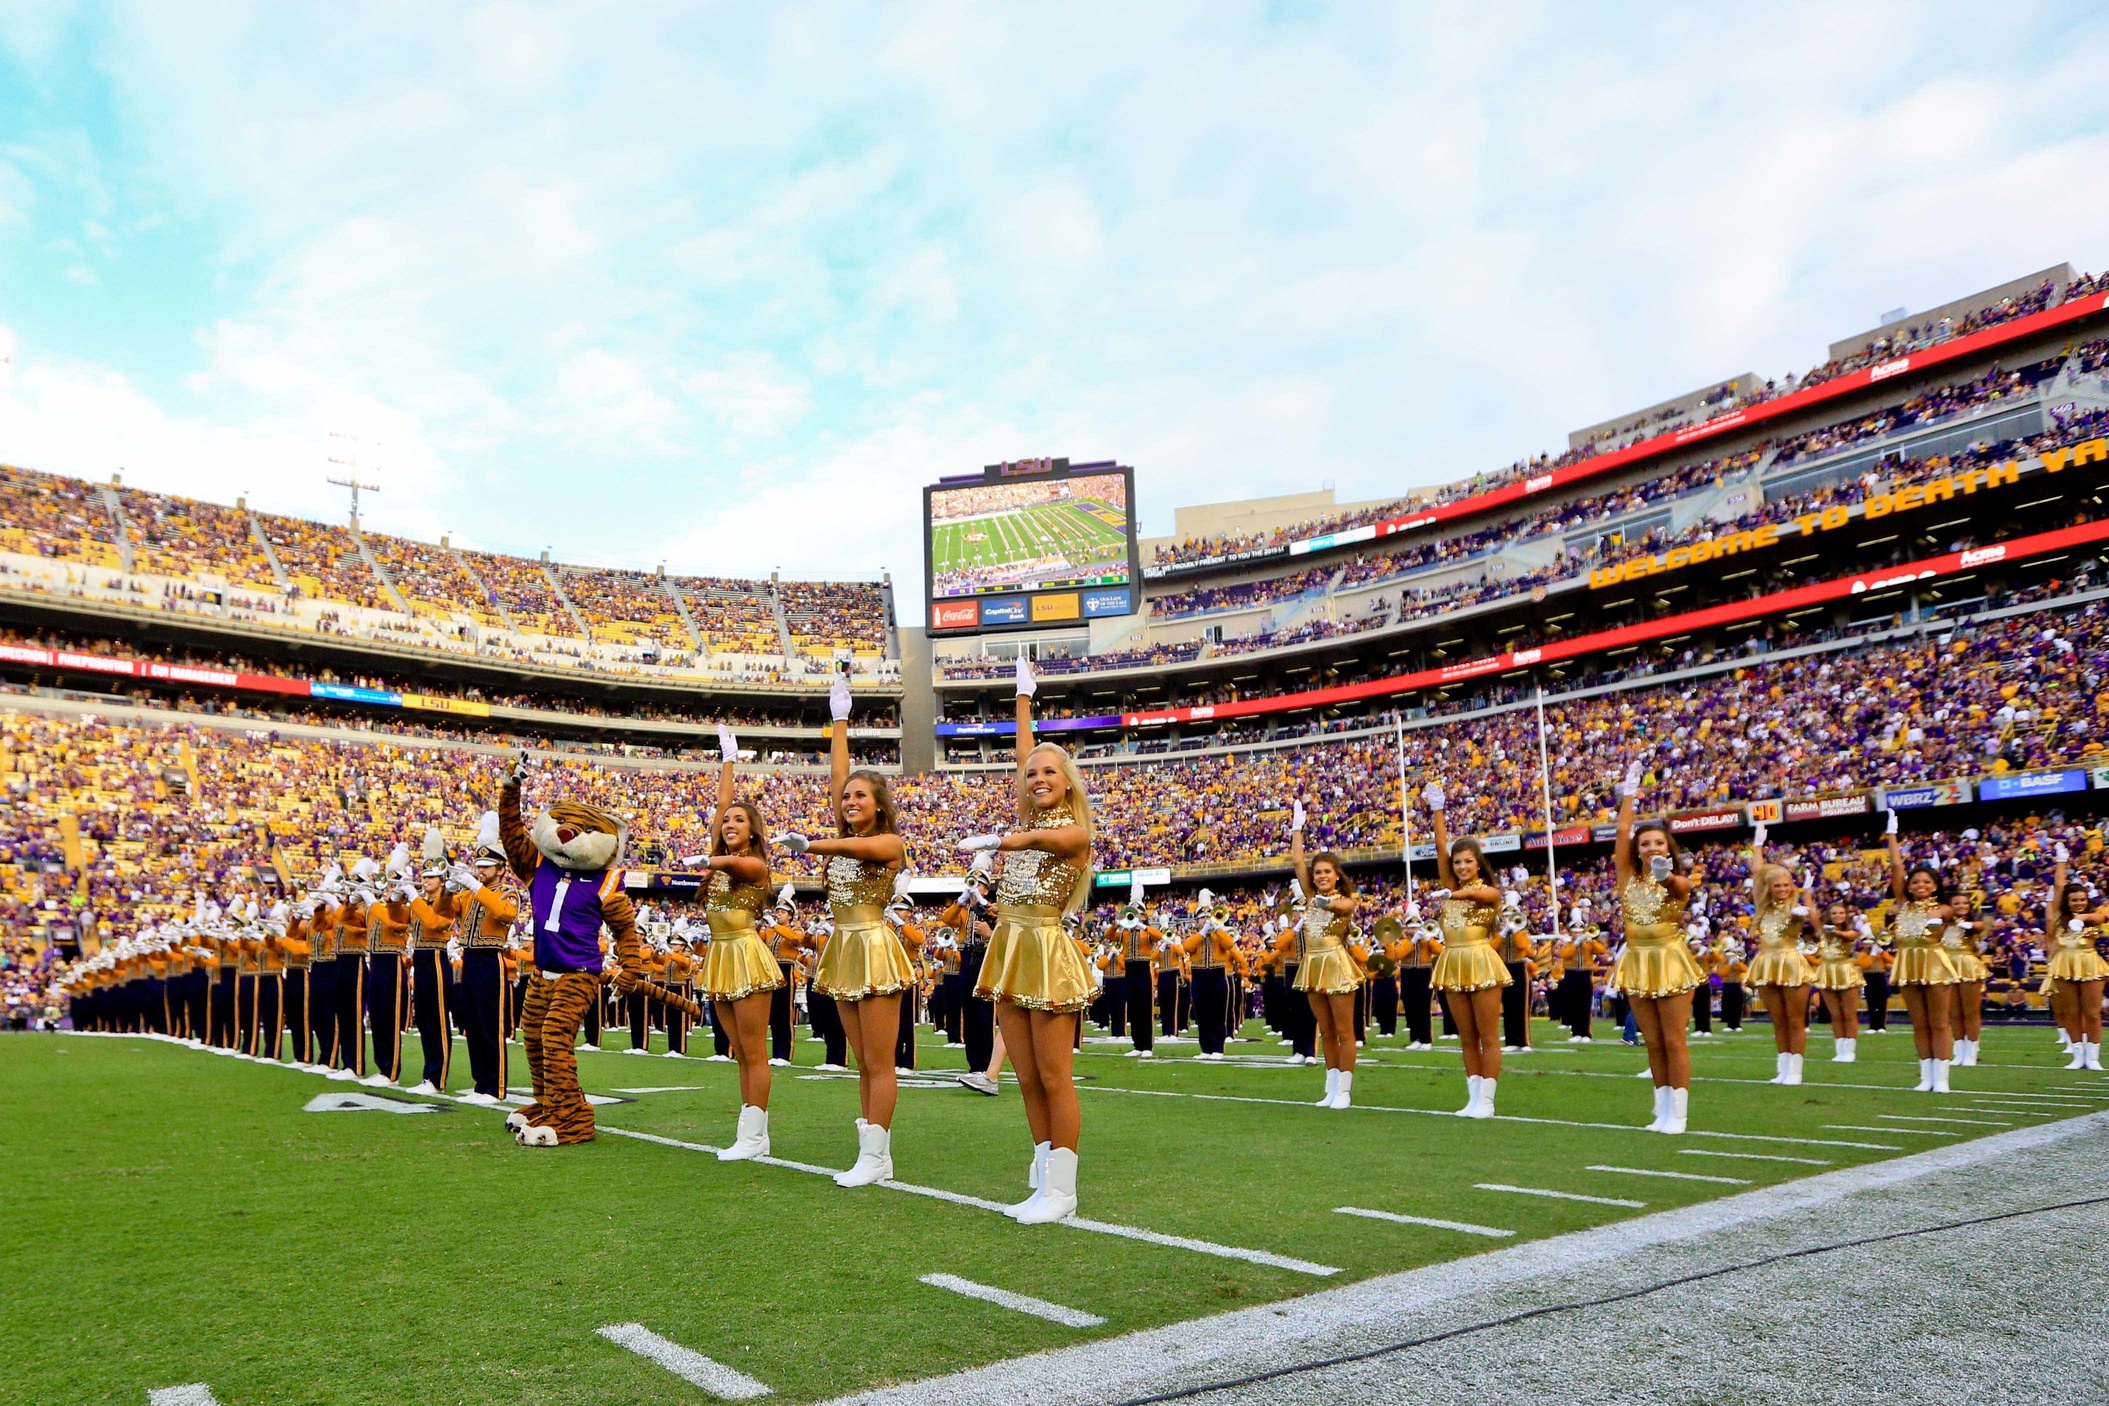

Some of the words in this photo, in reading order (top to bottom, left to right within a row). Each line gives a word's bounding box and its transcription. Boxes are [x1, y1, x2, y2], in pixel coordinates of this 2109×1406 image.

[1001, 456, 1052, 476] LSU
[1589, 523, 1780, 590] WELCOME
[1793, 505, 1849, 537] TO
[1864, 460, 2020, 521] DEATH
[2039, 437, 2108, 474] VA
[1172, 560, 1199, 571] PROUDLY
[1238, 552, 1251, 560] YOU
[1960, 545, 2006, 565] Acme
[1009, 612, 1025, 620] Bank
[421, 698, 450, 710] LSU
[2020, 773, 2064, 788] BASF
[1787, 801, 1819, 813] FARM
[1820, 795, 1866, 809] BUREAU
[1888, 791, 1933, 807] WBRZ
[1752, 803, 1779, 821] 40
[1821, 804, 1866, 817] INSURANCE
[1671, 818, 1700, 830] Don't
[1700, 812, 1739, 827] DELAY!
[544, 880, 570, 933] 1
